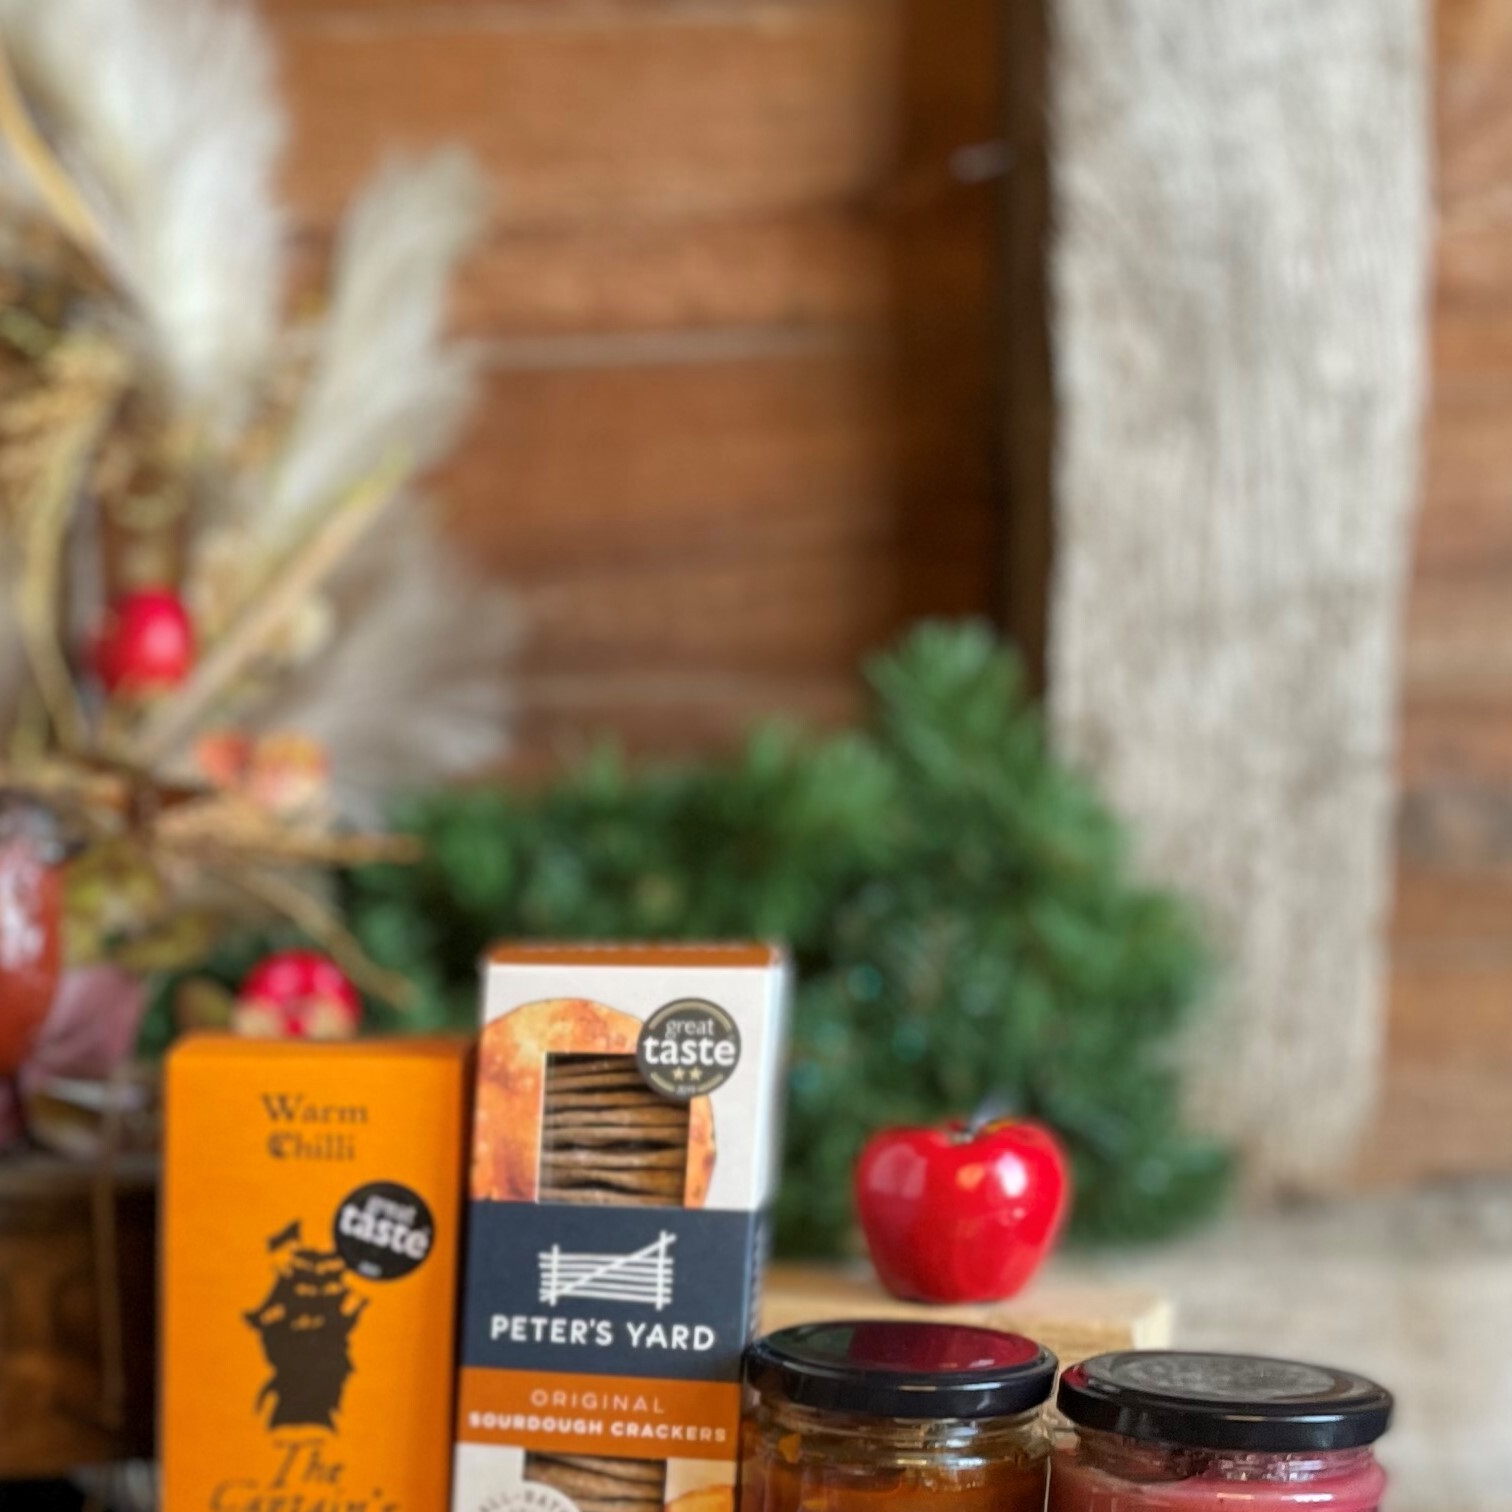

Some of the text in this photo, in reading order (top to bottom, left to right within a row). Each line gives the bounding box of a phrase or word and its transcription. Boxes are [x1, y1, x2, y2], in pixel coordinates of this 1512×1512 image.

[665, 1017, 714, 1040] great
[643, 1036, 735, 1066] taste
[262, 1092, 368, 1124] Warm
[266, 1131, 355, 1160] Chilli
[339, 1202, 430, 1260] taste
[490, 1314, 716, 1351] PETER'S YARD
[530, 1389, 664, 1414] ORIGINAL
[468, 1411, 727, 1443] SOURDOUGH CRACKERS
[271, 1437, 345, 1490] The
